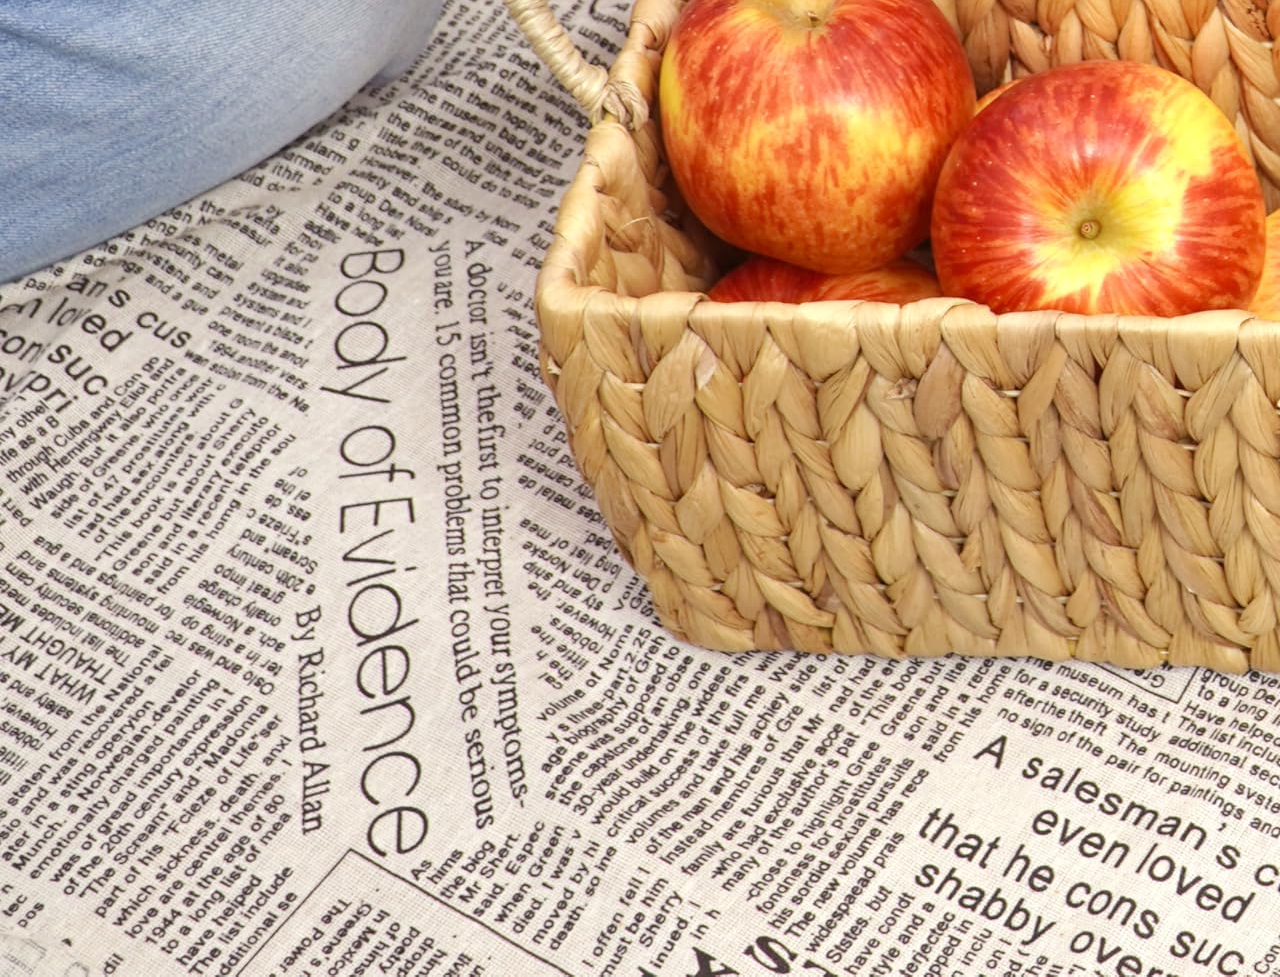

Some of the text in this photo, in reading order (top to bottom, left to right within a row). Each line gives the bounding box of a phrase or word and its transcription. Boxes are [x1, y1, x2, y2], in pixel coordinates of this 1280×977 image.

[464, 239, 486, 259] A
[466, 262, 493, 326] doctor
[135, 311, 193, 349] cus
[434, 320, 463, 347] 15
[46, 344, 109, 396] suc
[438, 352, 463, 458] common
[435, 460, 473, 556] problems
[479, 475, 504, 501] to
[304, 247, 429, 858] Body of Evidence
[475, 505, 510, 598] interpret
[447, 561, 476, 605] that
[18, 626, 113, 686] THAUGHT
[449, 609, 482, 685] could
[482, 603, 511, 658] your
[33, 662, 97, 706] WHAT
[162, 678, 221, 736] painting
[458, 682, 484, 723] be
[1055, 664, 1124, 701] museum
[202, 704, 269, 769] Madonna
[291, 604, 331, 836] By Richard Allan
[1051, 684, 1162, 744] security study
[1177, 715, 1207, 737] The
[1183, 700, 1226, 726] Have
[1232, 699, 1269, 722] long
[133, 695, 253, 820] century expression
[972, 734, 1008, 770] A
[1117, 731, 1148, 756] The
[1153, 751, 1232, 790] mounting
[1167, 735, 1249, 769] additional
[464, 728, 495, 830] serious
[1142, 766, 1169, 786] for
[1165, 780, 1245, 821] paintings
[918, 807, 1245, 977] that he cons suc
[1031, 809, 1257, 924] even loved
[914, 863, 1057, 947] shabby
